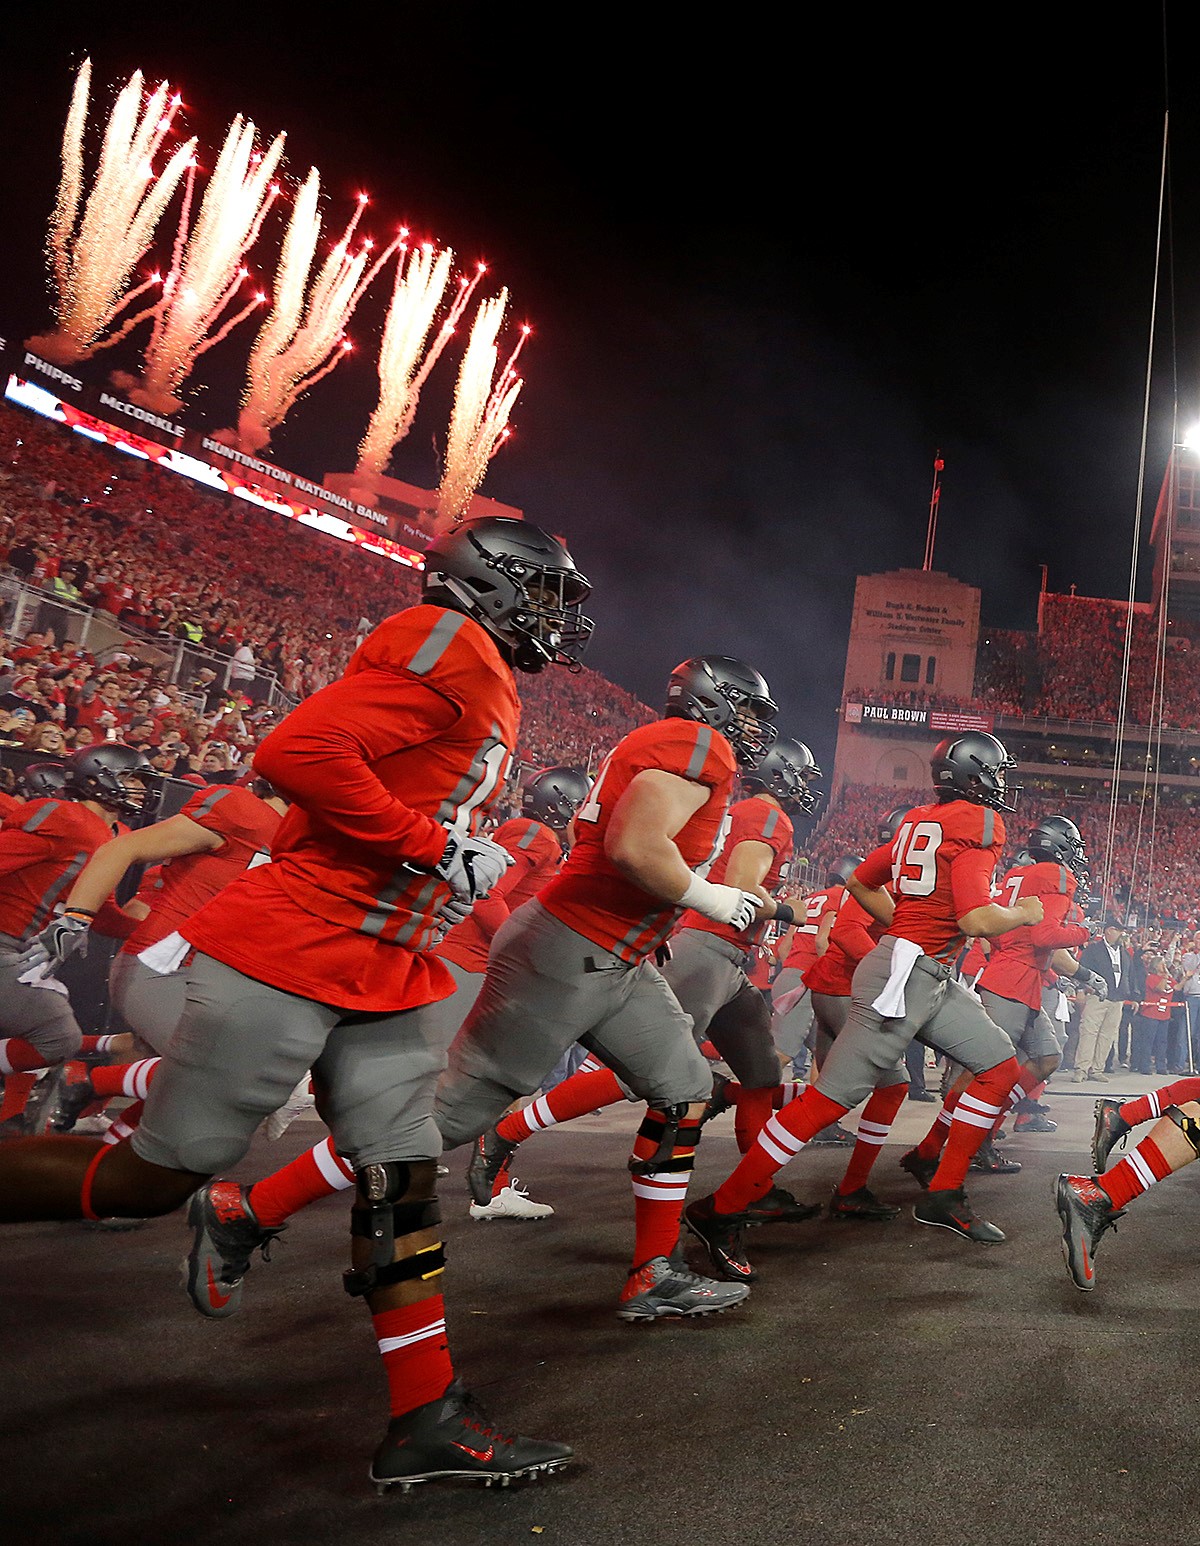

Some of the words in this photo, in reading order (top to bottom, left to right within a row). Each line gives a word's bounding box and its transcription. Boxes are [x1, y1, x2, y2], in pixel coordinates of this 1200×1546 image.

[24, 352, 84, 393] PHIPPS
[99, 392, 187, 438] McCORKLE
[202, 437, 292, 485] HUNTINGTON
[294, 478, 354, 513] NATIONAL
[355, 504, 389, 526] BANK
[863, 706, 889, 720] PAUL
[891, 708, 927, 723] BROWN
